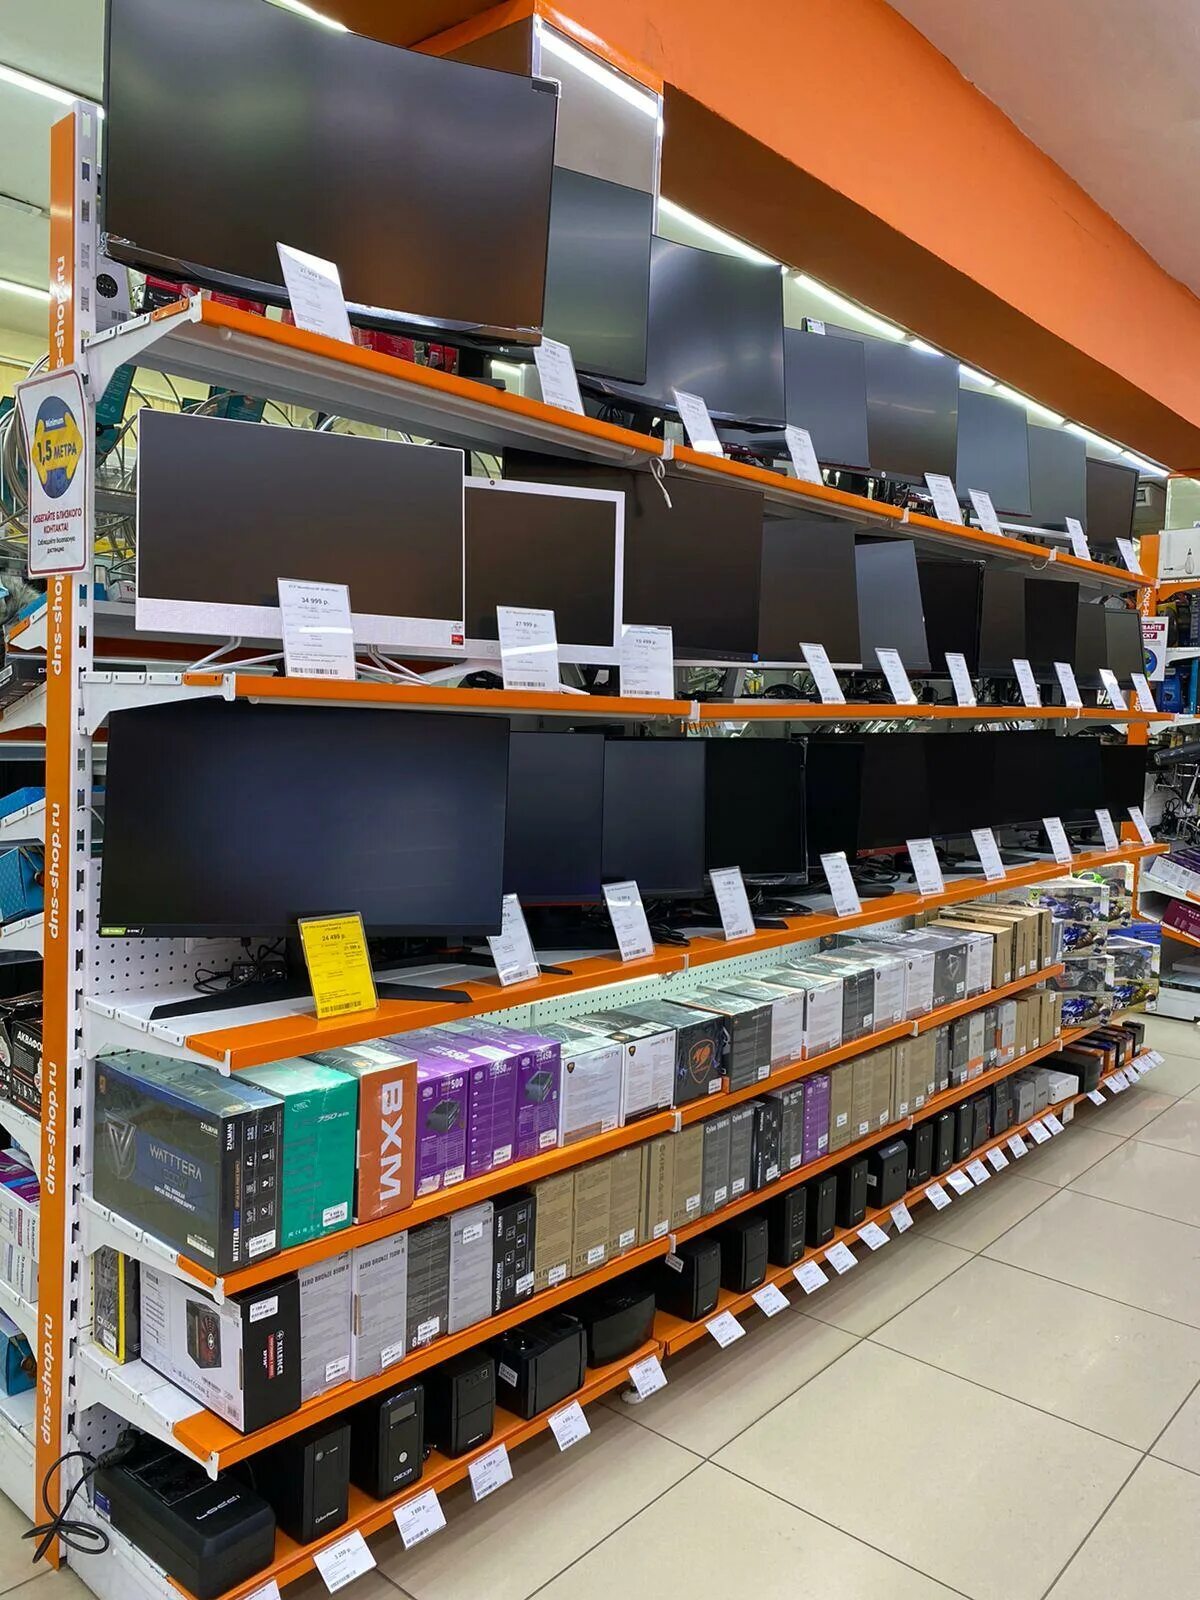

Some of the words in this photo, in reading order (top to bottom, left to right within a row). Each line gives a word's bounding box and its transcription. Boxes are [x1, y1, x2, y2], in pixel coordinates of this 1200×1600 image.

[37, 439, 52, 466] 1,5
[54, 442, 77, 459] МЕТРА
[48, 803, 62, 939] dns-shop.ru
[44, 1062, 59, 1195] dns-shop.ru
[200, 1121, 218, 1135] ZALMAN
[226, 1123, 236, 1150] ZALMAN
[380, 1080, 403, 1200] BXM
[232, 1228, 241, 1262] WATTTERA
[276, 1340, 284, 1376] XILENCE
[42, 1314, 55, 1444] dns-shop.ru
